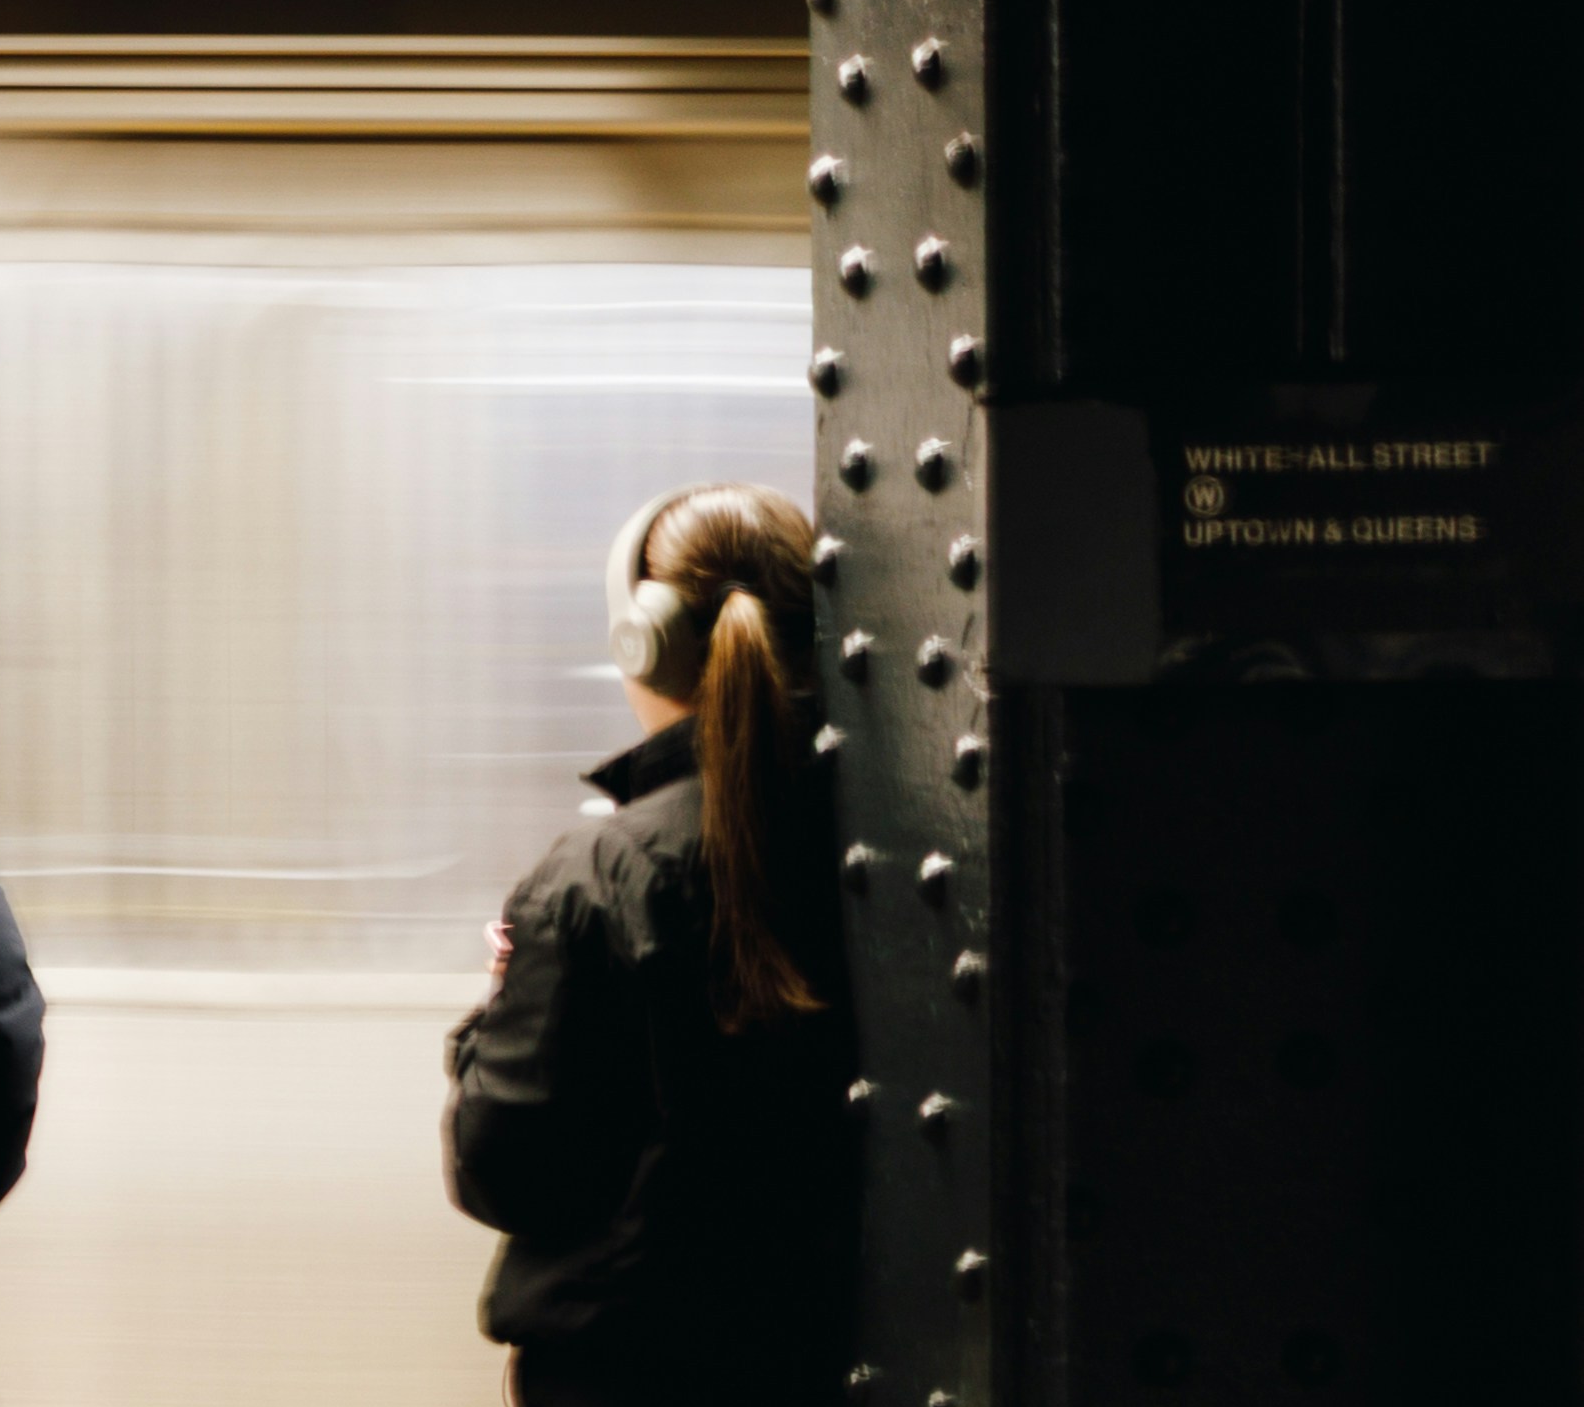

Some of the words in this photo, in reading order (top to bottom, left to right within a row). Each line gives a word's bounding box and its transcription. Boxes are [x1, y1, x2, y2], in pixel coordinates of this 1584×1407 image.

[1372, 440, 1494, 471] STREET
[1183, 517, 1316, 546] UPTOWN
[1324, 516, 1344, 545] &
[1351, 513, 1480, 545] QUEENS
